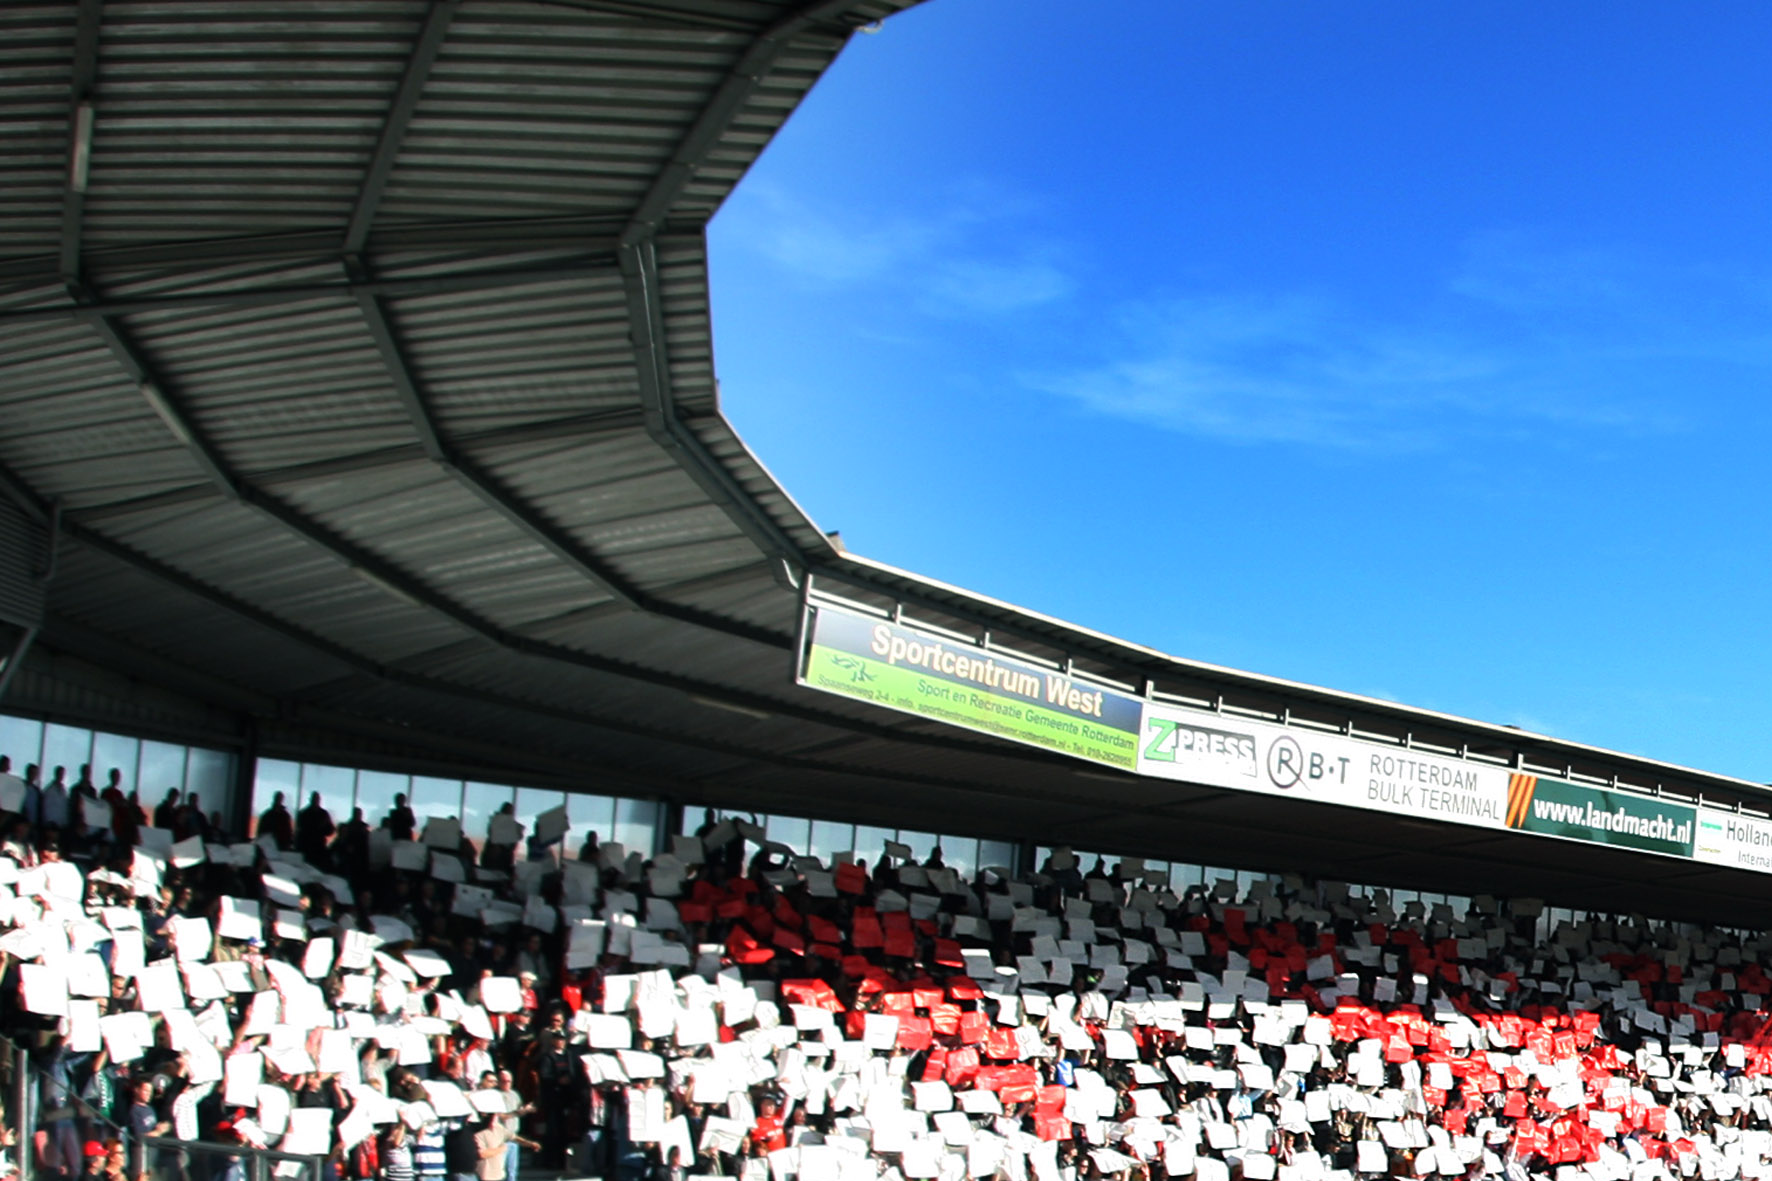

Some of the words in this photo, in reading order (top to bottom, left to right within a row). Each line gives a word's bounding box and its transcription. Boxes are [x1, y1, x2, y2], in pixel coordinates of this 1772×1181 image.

[871, 624, 1041, 698] Sportcentrum
[1046, 675, 1103, 717] West
[917, 679, 950, 700] Sport
[952, 691, 967, 705] en
[970, 694, 1023, 720] Recreatie
[1025, 709, 1079, 736] Gemeente
[1081, 725, 1134, 750] Rotterdam
[1369, 754, 1479, 793] ROTTERDAM
[1367, 779, 1413, 808] BULK
[1420, 788, 1501, 822] TERMINAL
[1534, 797, 1692, 845] www.landmacht.nl
